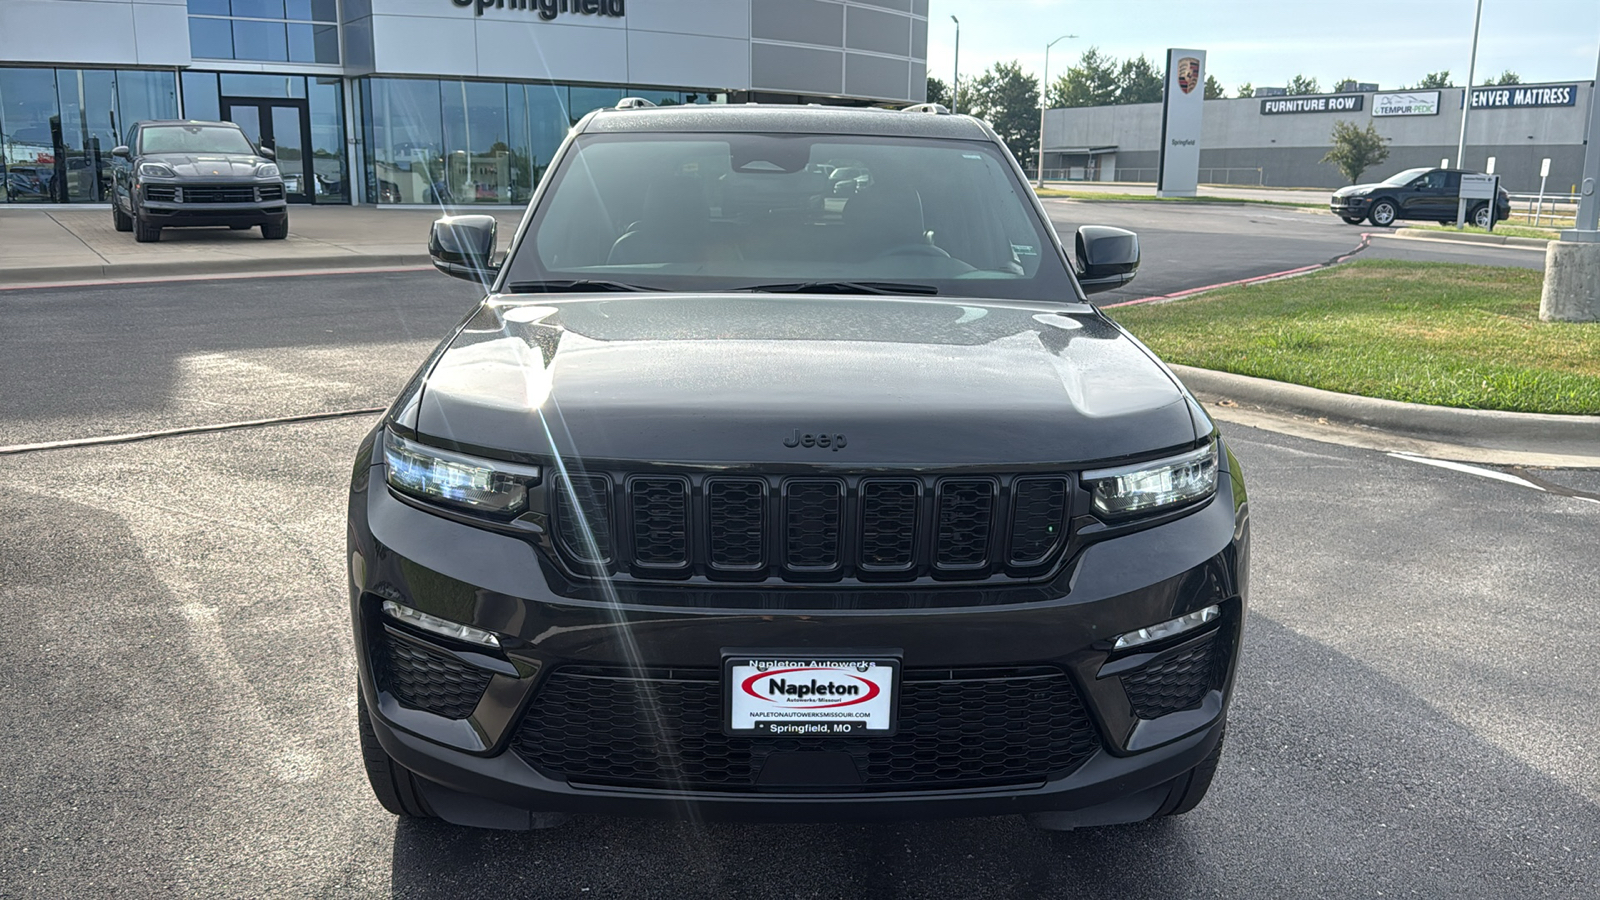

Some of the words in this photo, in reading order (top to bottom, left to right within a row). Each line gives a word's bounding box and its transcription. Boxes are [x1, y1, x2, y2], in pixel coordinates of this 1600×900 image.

[453, 0, 625, 20] pngfield
[1265, 98, 1326, 113] FURNITURE
[1328, 97, 1356, 110] ROW
[1471, 90, 1510, 107] ENVER
[1514, 88, 1570, 105] MATTRESS
[1171, 138, 1195, 148] Springfield
[782, 427, 848, 452] Jeep
[748, 660, 805, 668] Napleton
[809, 660, 876, 668] Autowerks
[768, 678, 859, 698] Napleton
[749, 711, 871, 719] NAPLETONAUTOWERKSMISSOURI.COM
[769, 723, 831, 734] Springfield,
[833, 723, 851, 733] MO
